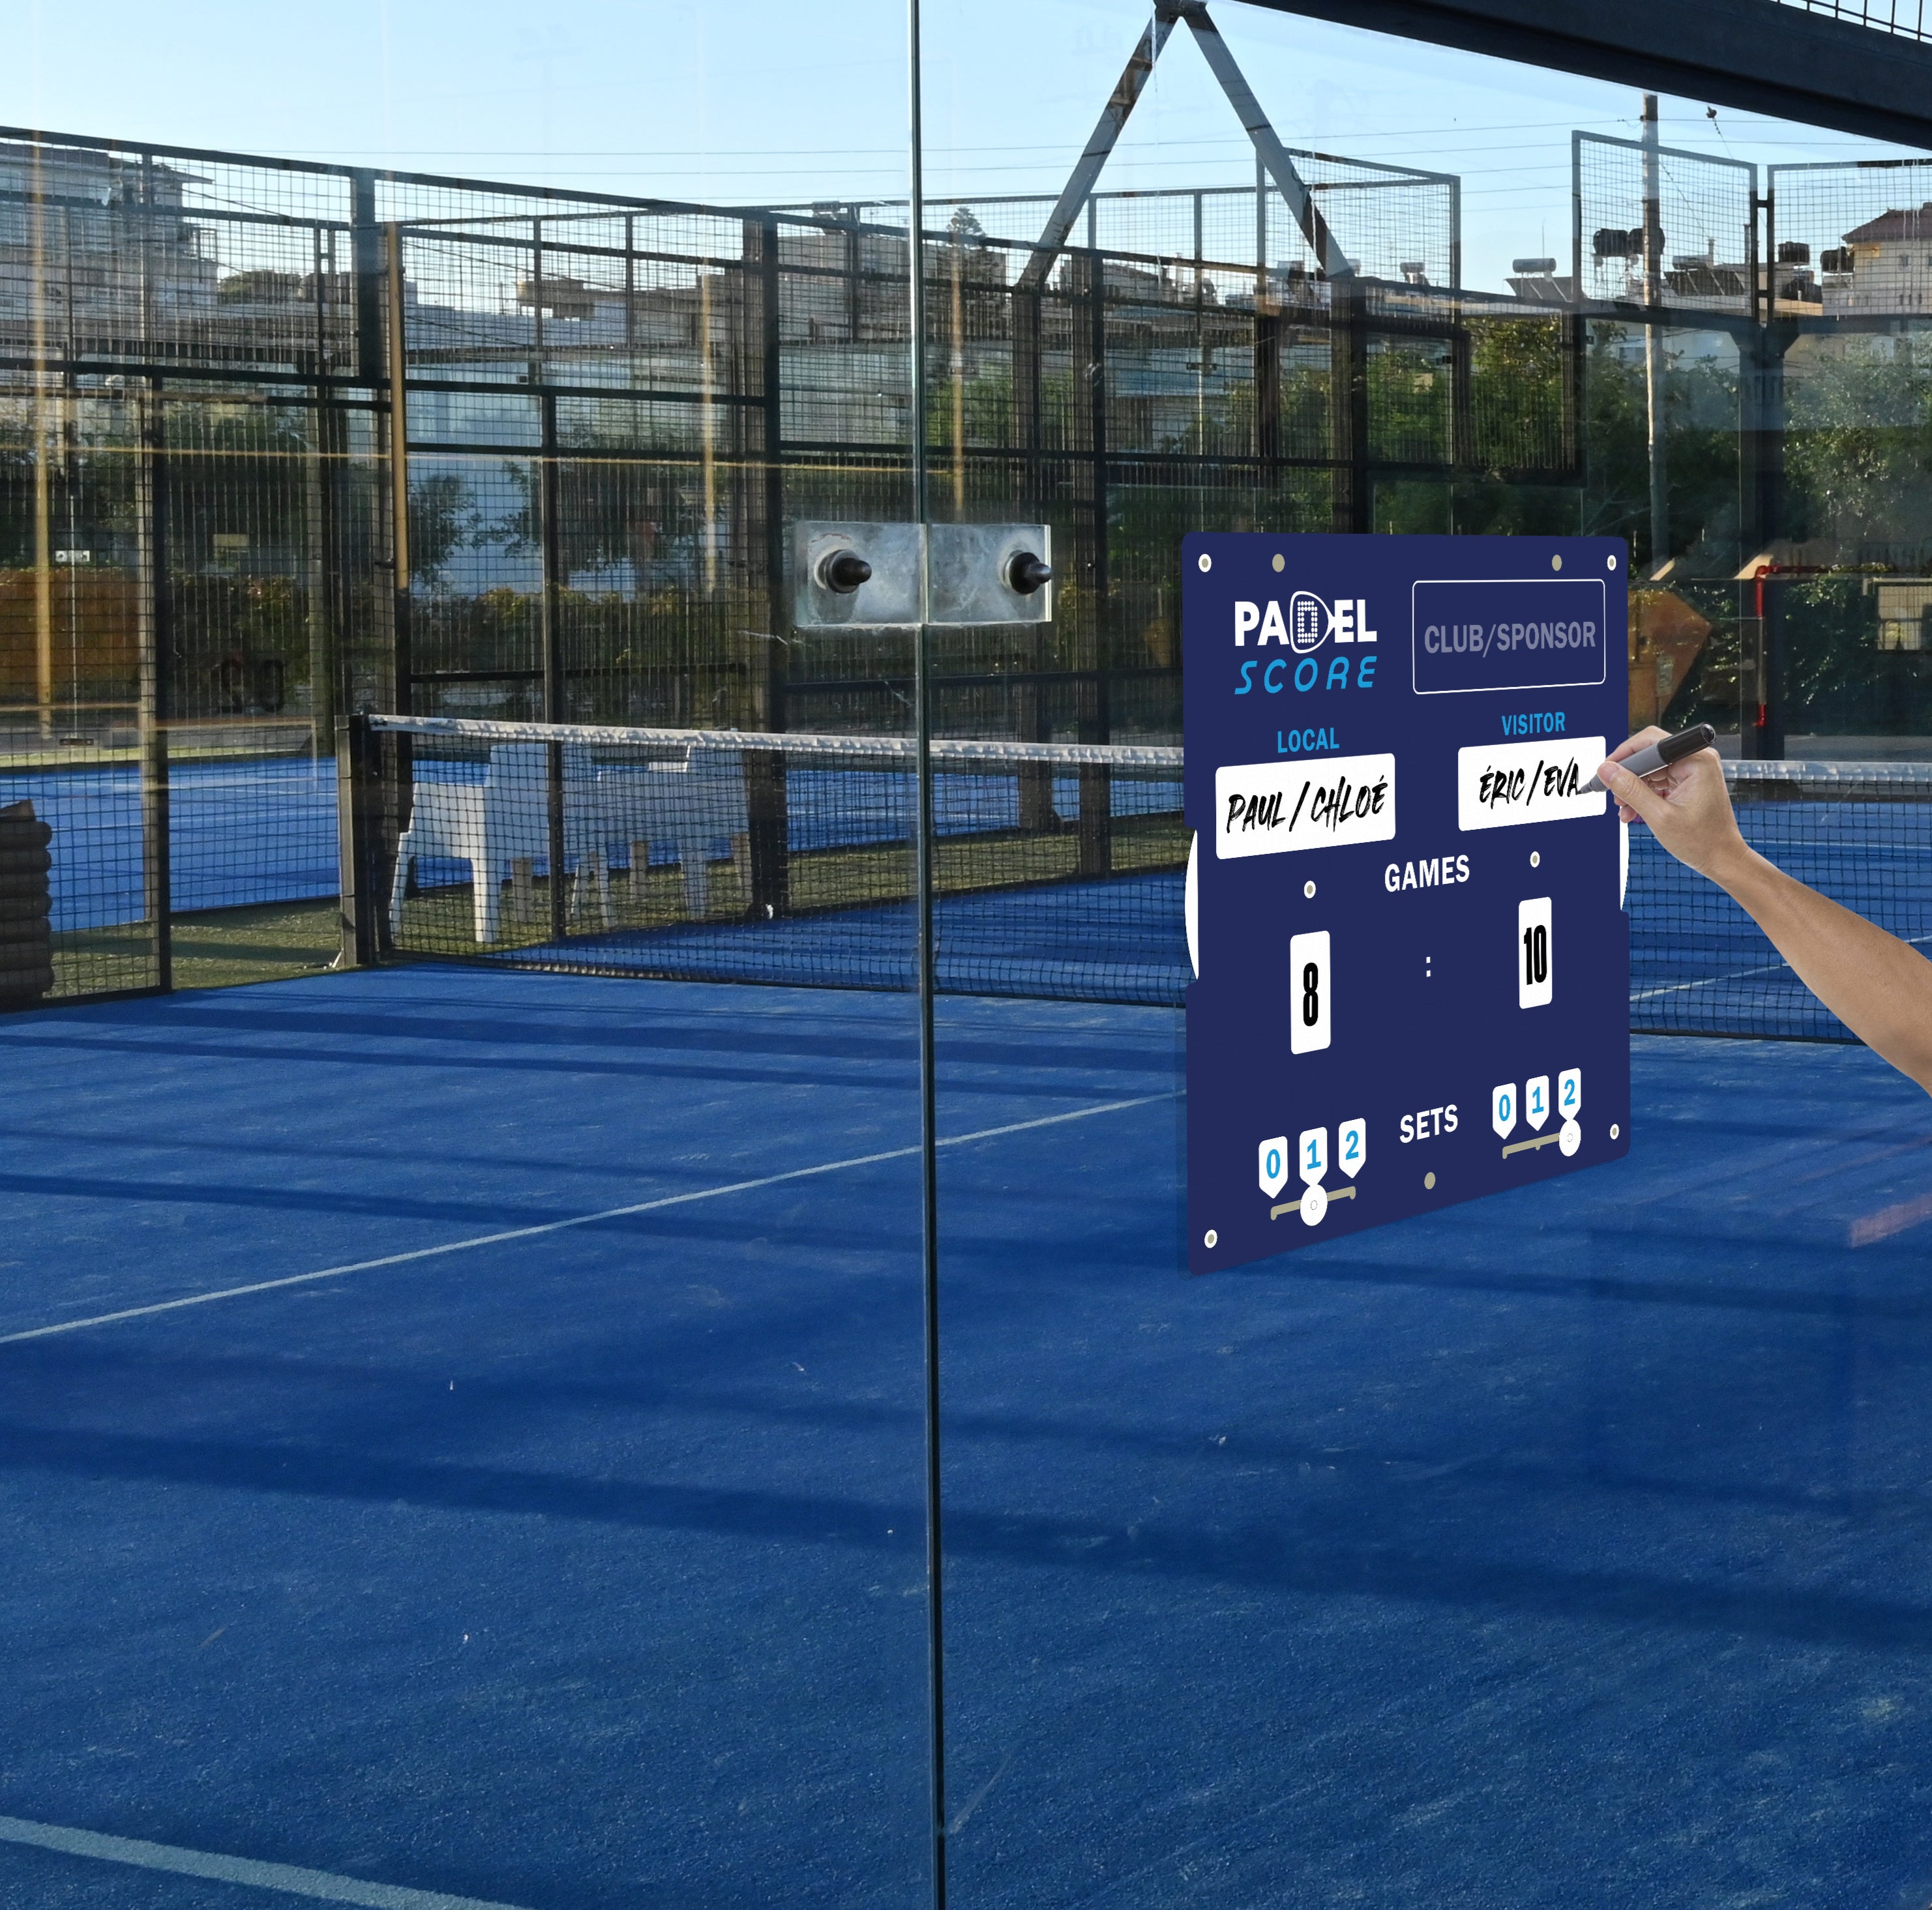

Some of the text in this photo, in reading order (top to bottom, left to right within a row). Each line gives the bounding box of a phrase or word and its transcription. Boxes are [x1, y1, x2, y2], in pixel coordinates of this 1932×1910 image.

[1235, 591, 1377, 654] PADEL
[1425, 621, 1596, 658] CLUB/SPONSOR
[1235, 656, 1377, 695] SCORE
[1277, 727, 1340, 753] LOCAL
[1502, 712, 1566, 735] VISITOR
[1384, 854, 1470, 892] GAMES
[1303, 962, 1318, 1027] 8
[1523, 924, 1547, 986] 10
[1498, 1078, 1576, 1122] 0 1 2
[1399, 1104, 1459, 1143] SETS
[1266, 1130, 1359, 1179] 0 1 2
